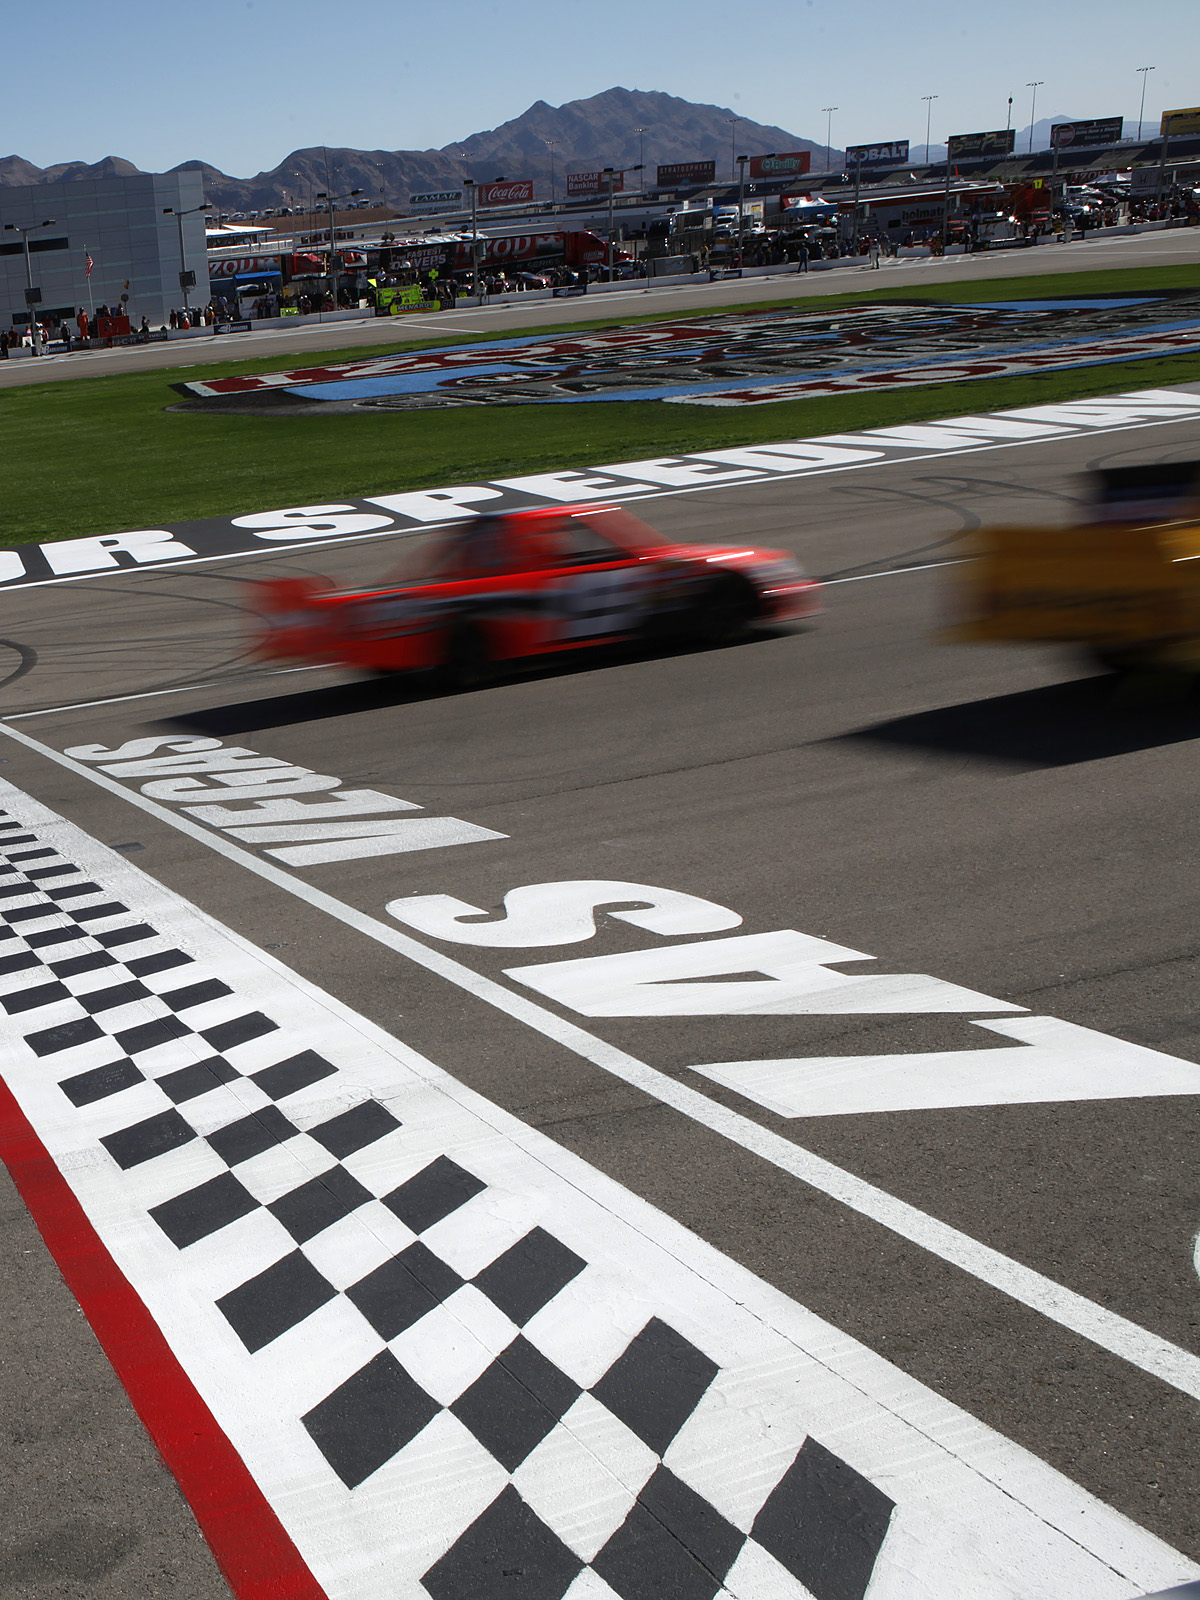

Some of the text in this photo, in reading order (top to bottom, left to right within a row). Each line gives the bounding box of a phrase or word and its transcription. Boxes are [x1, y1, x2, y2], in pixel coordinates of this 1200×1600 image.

[846, 144, 908, 164] KOBALT
[659, 163, 713, 174] STRATOSPHERE
[568, 173, 599, 182] NASCAR
[1033, 178, 1043, 189] 17
[568, 180, 599, 191] Banking
[414, 193, 457, 202] LAMAR
[902, 205, 945, 220] holmatr
[407, 245, 443, 259] FASTEST
[391, 253, 447, 271] DVERS
[527, 258, 561, 269] SERIES
[397, 302, 434, 311] MENARDS
[555, 313, 942, 361] INDYCAR
[243, 332, 673, 388] IZOD
[353, 301, 1200, 410] CHAMPIONSHI
[231, 388, 1200, 541] SPEEDWAY
[64, 734, 1200, 1118] LAS VEGAS
